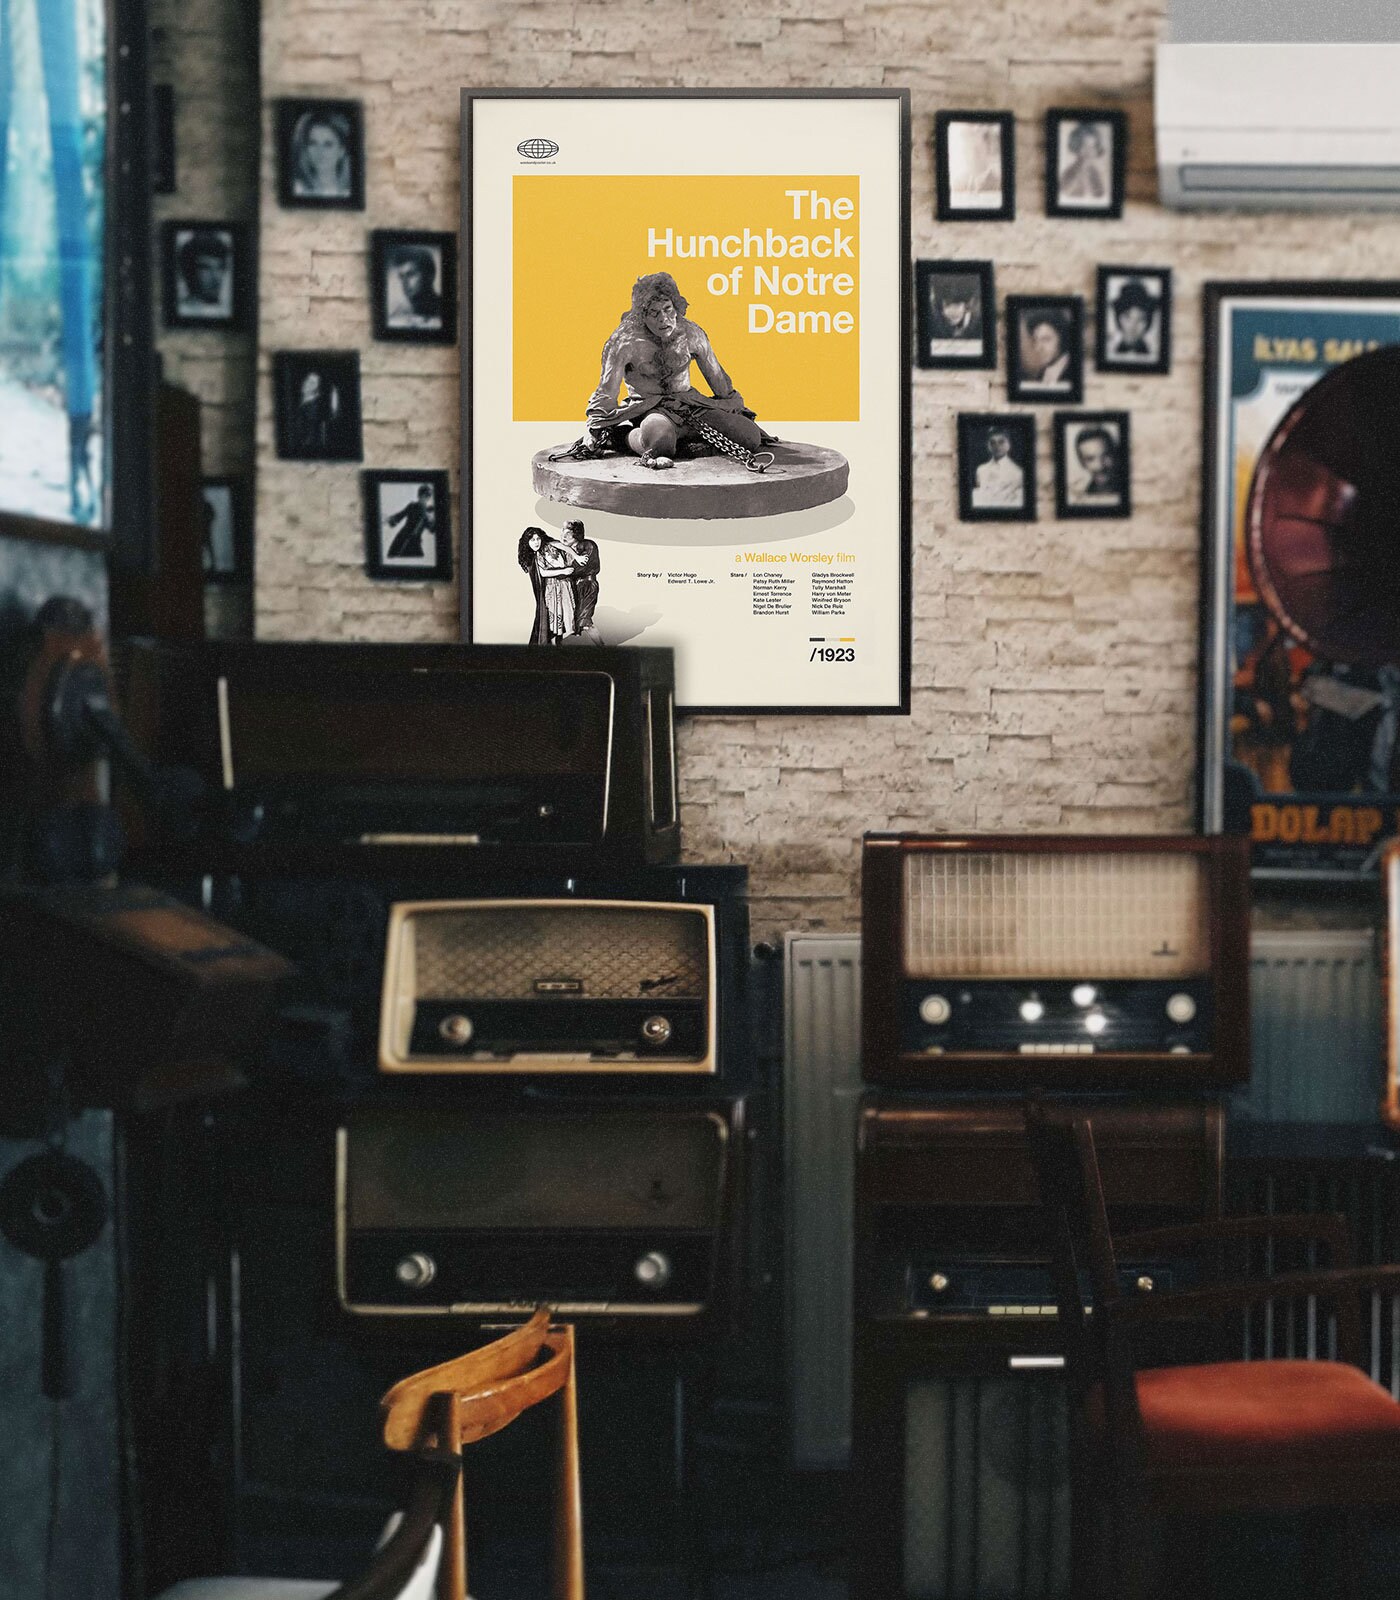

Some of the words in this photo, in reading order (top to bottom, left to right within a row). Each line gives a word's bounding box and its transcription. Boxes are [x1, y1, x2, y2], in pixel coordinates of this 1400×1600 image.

[785, 190, 855, 221] The
[647, 227, 855, 259] Hunchback
[707, 266, 743, 296] of
[754, 266, 855, 296] Notre
[748, 304, 855, 334] Dame
[735, 554, 742, 563] a
[744, 553, 787, 563] Wallace
[789, 553, 834, 565] Worsley
[836, 553, 856, 563] film
[810, 648, 856, 662] /1923
[1251, 804, 1383, 844] DOLAP
